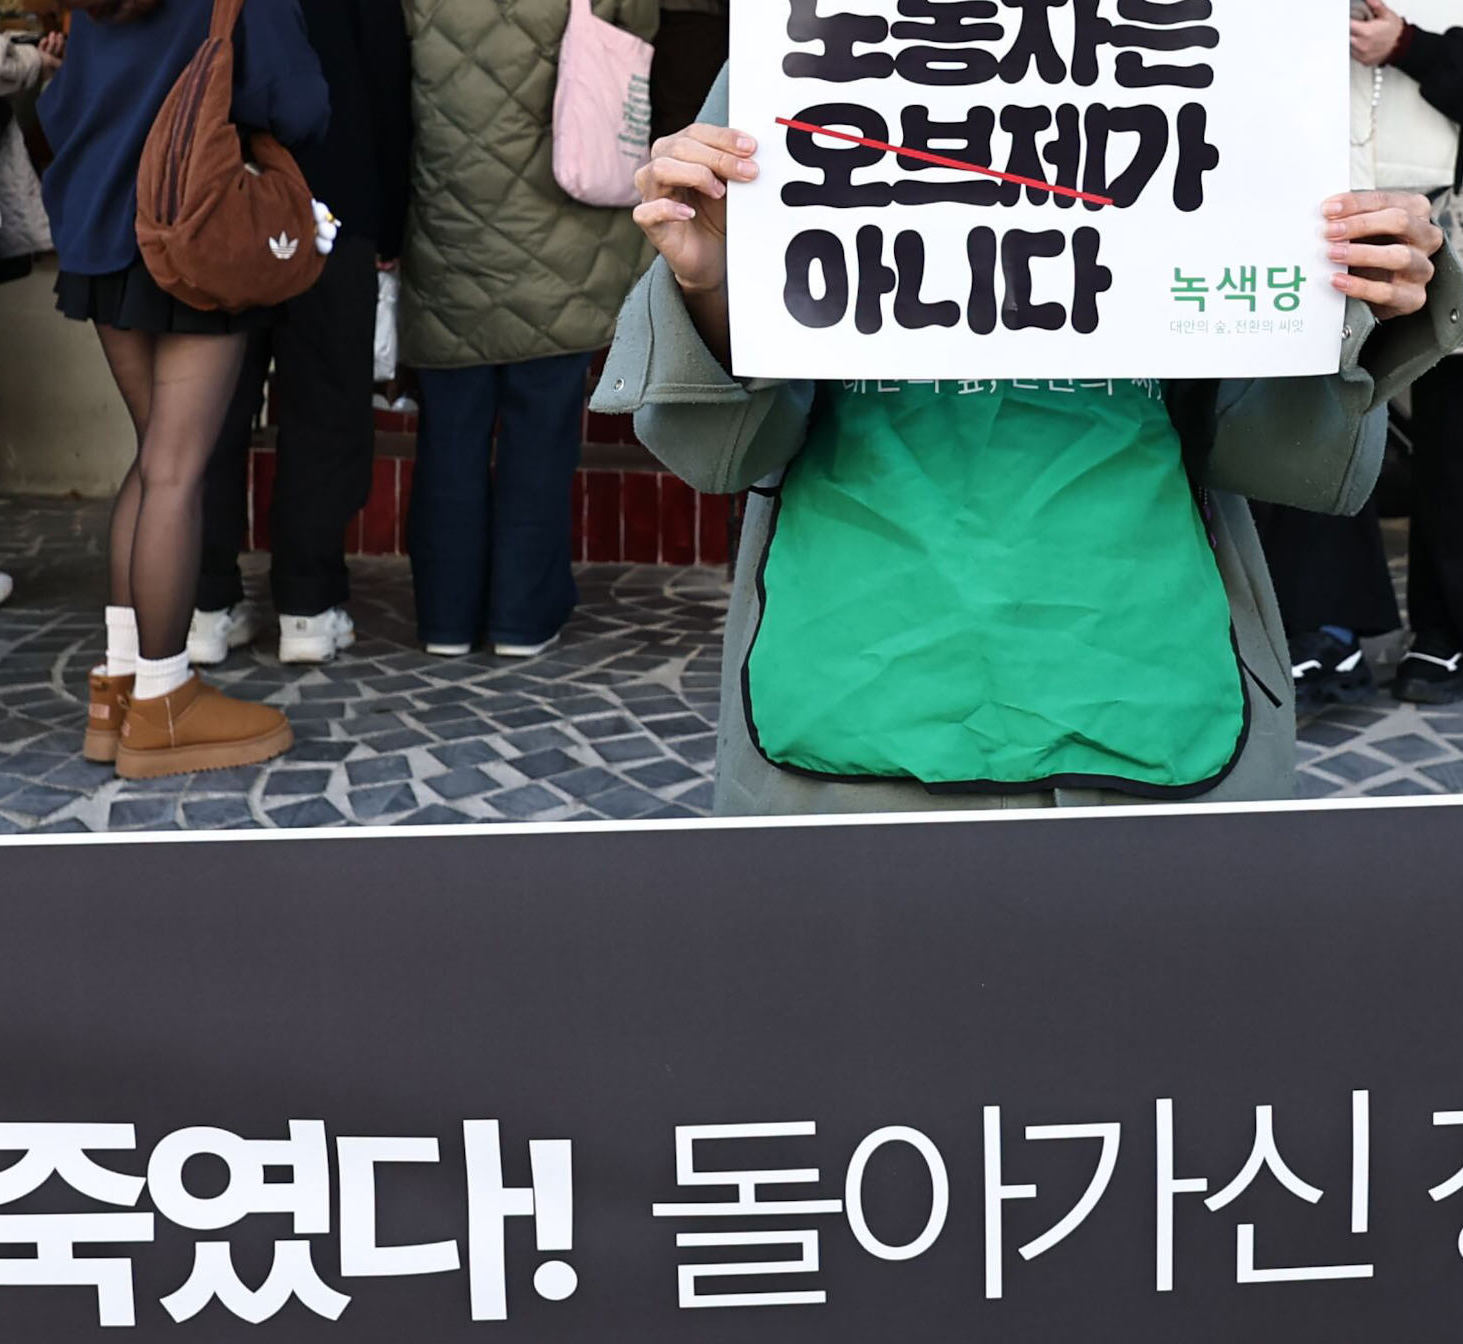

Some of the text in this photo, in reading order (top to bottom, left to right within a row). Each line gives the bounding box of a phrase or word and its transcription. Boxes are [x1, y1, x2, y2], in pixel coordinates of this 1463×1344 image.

[780, 102, 1220, 212] 오브제가
[783, 224, 1113, 335] 아니다
[1169, 319, 1209, 335] 대안의
[1236, 319, 1274, 335] 전환의
[1279, 319, 1304, 334] 씨앗
[1170, 265, 1307, 312] 녹색당
[652, 1087, 1375, 1309] 돌아가신
